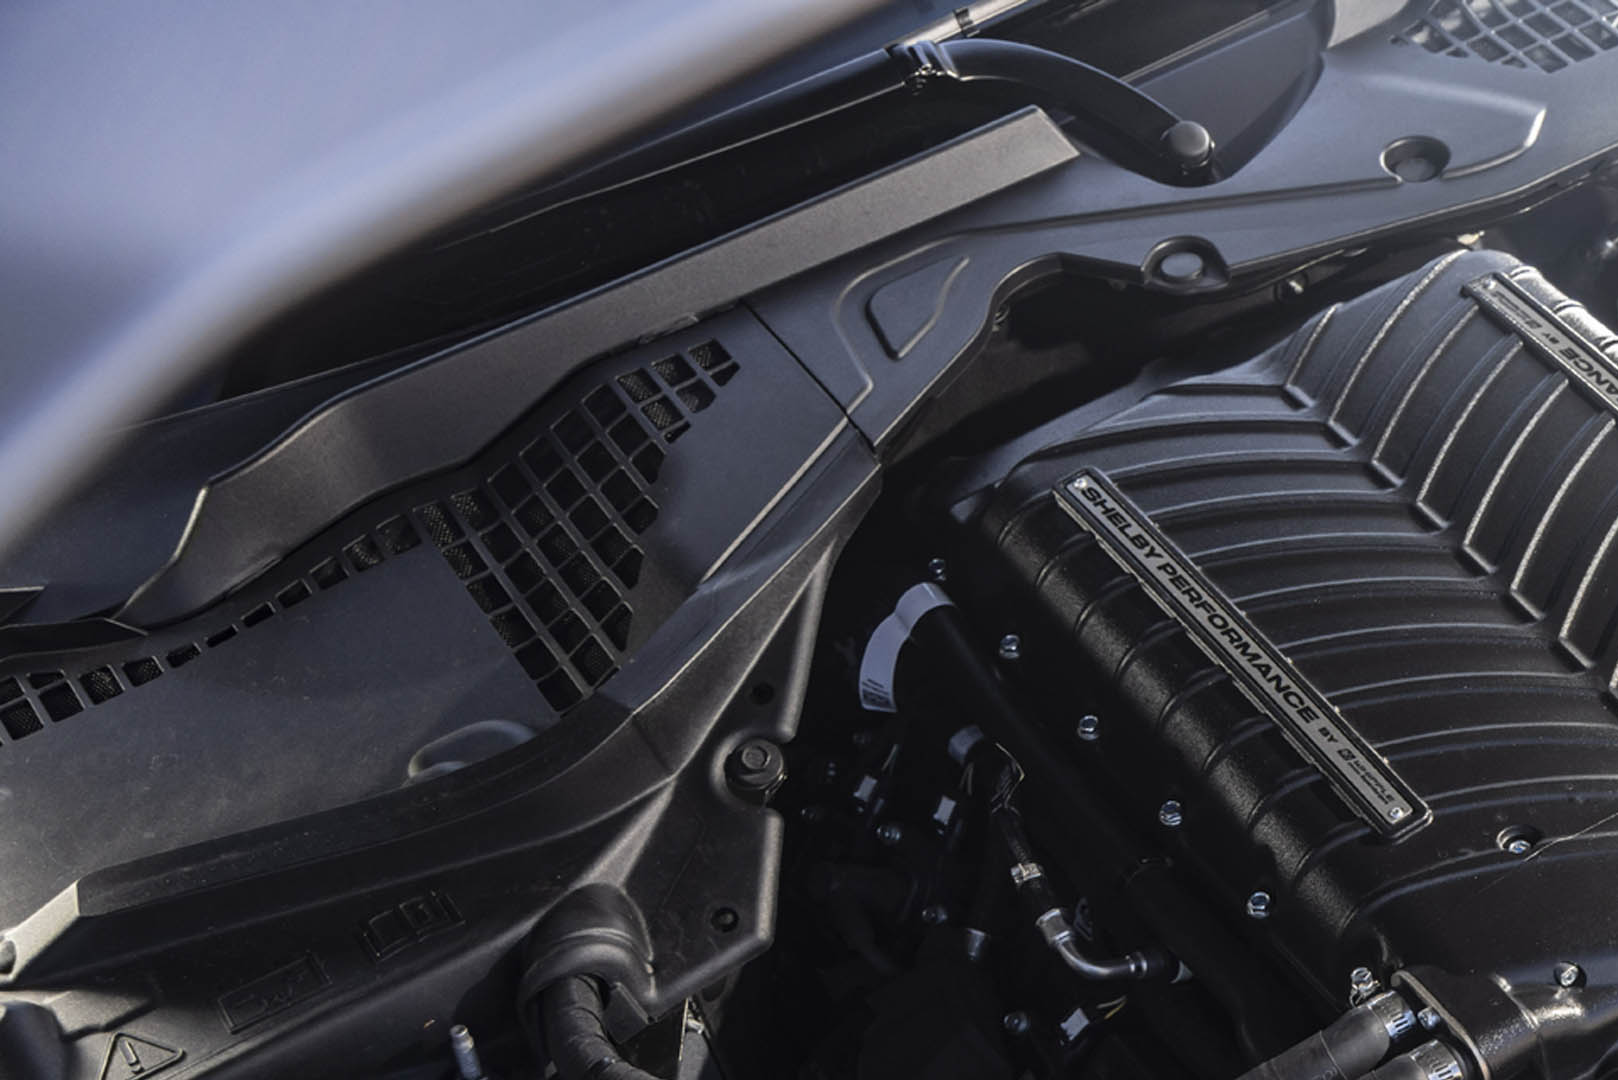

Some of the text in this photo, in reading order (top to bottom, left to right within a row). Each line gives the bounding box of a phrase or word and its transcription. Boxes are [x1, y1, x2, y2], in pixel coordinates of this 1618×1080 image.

[1081, 485, 1339, 745] SHELBY PERFORMANCE BY
